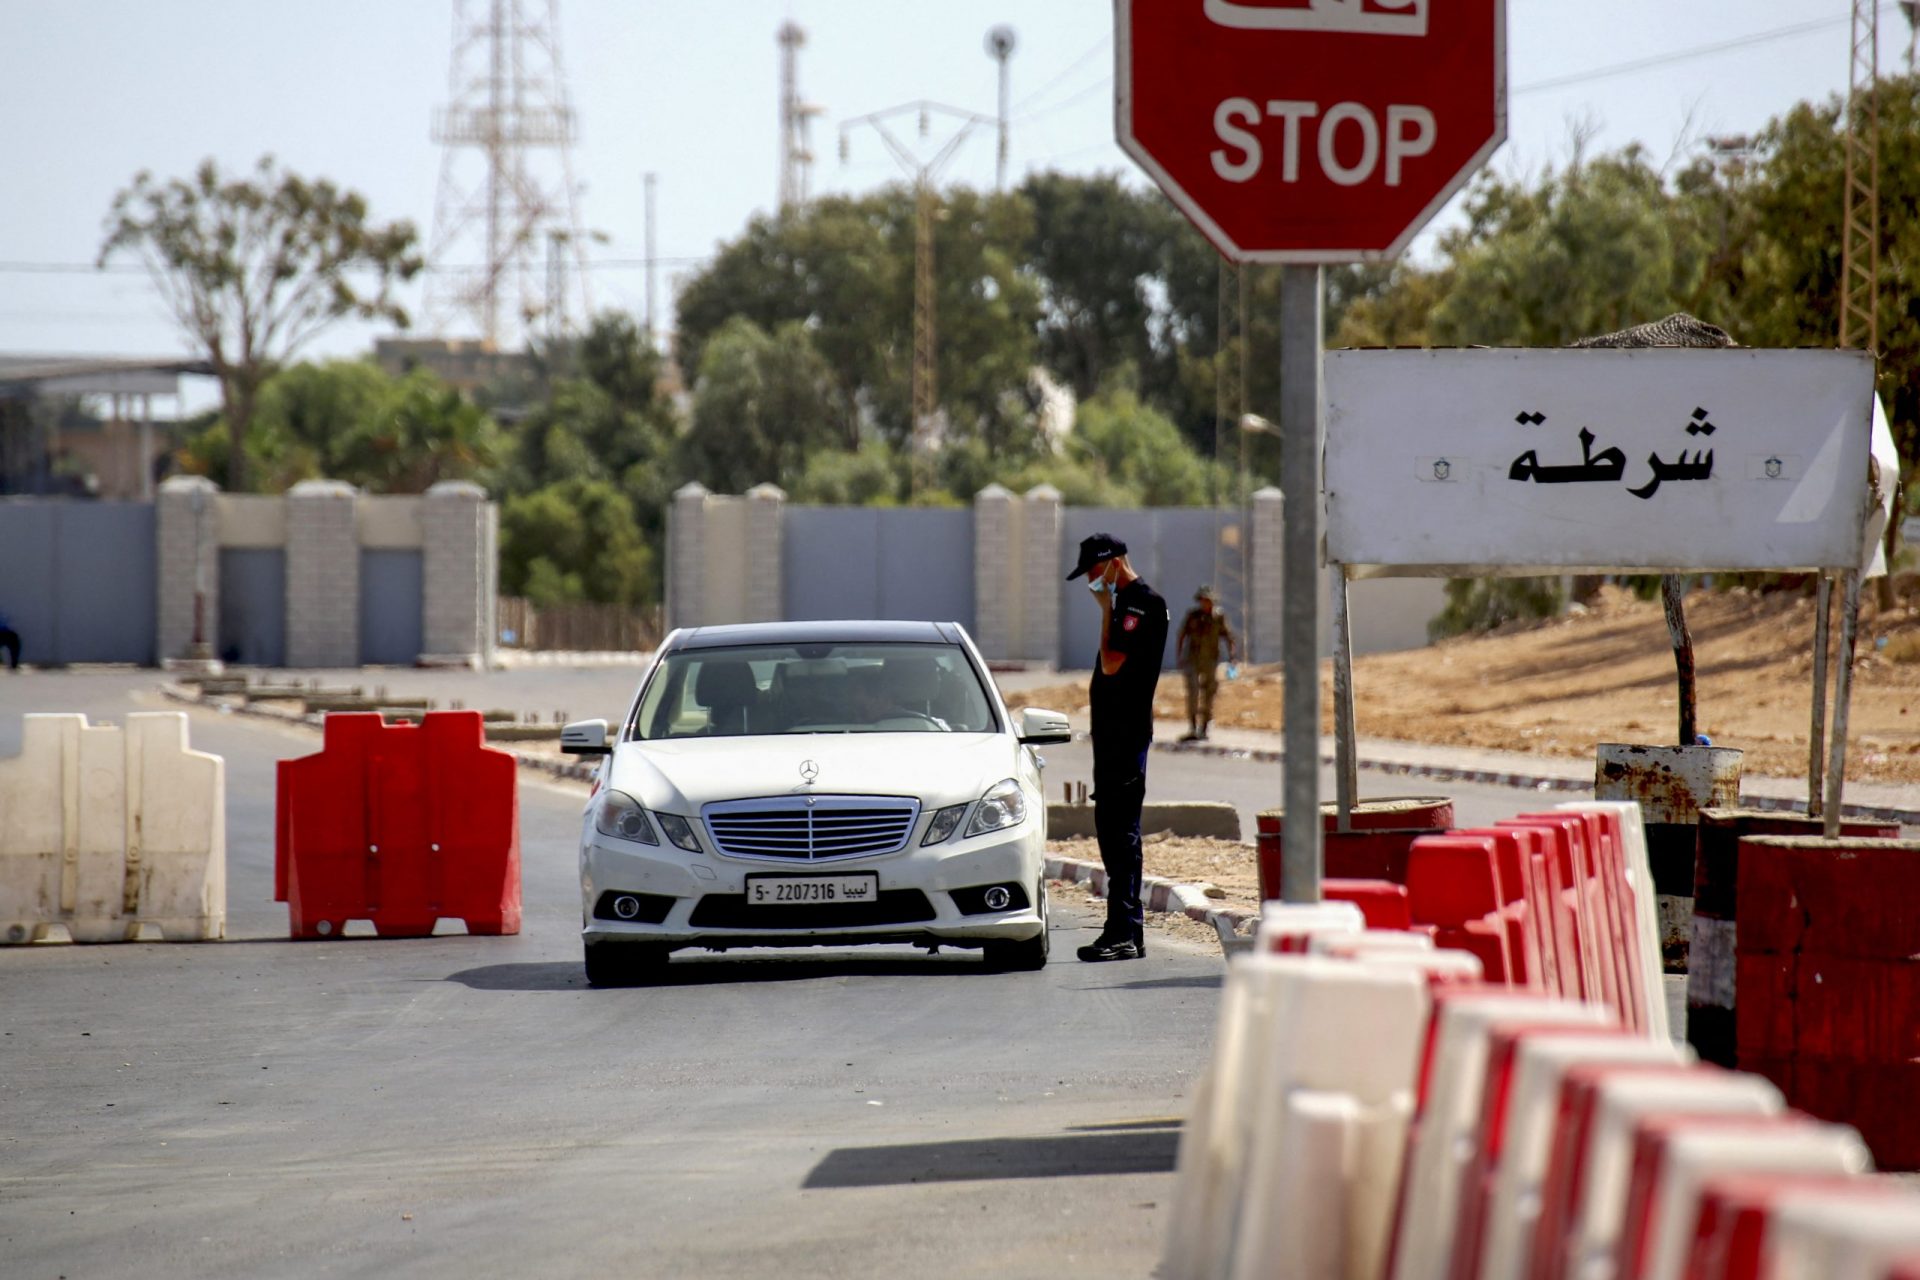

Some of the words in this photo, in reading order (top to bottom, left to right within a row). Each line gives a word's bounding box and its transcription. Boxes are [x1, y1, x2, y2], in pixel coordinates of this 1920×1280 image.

[1210, 97, 1437, 187] STOP
[1508, 406, 1716, 499] شرطة
[842, 882, 868, 898] ليبيا
